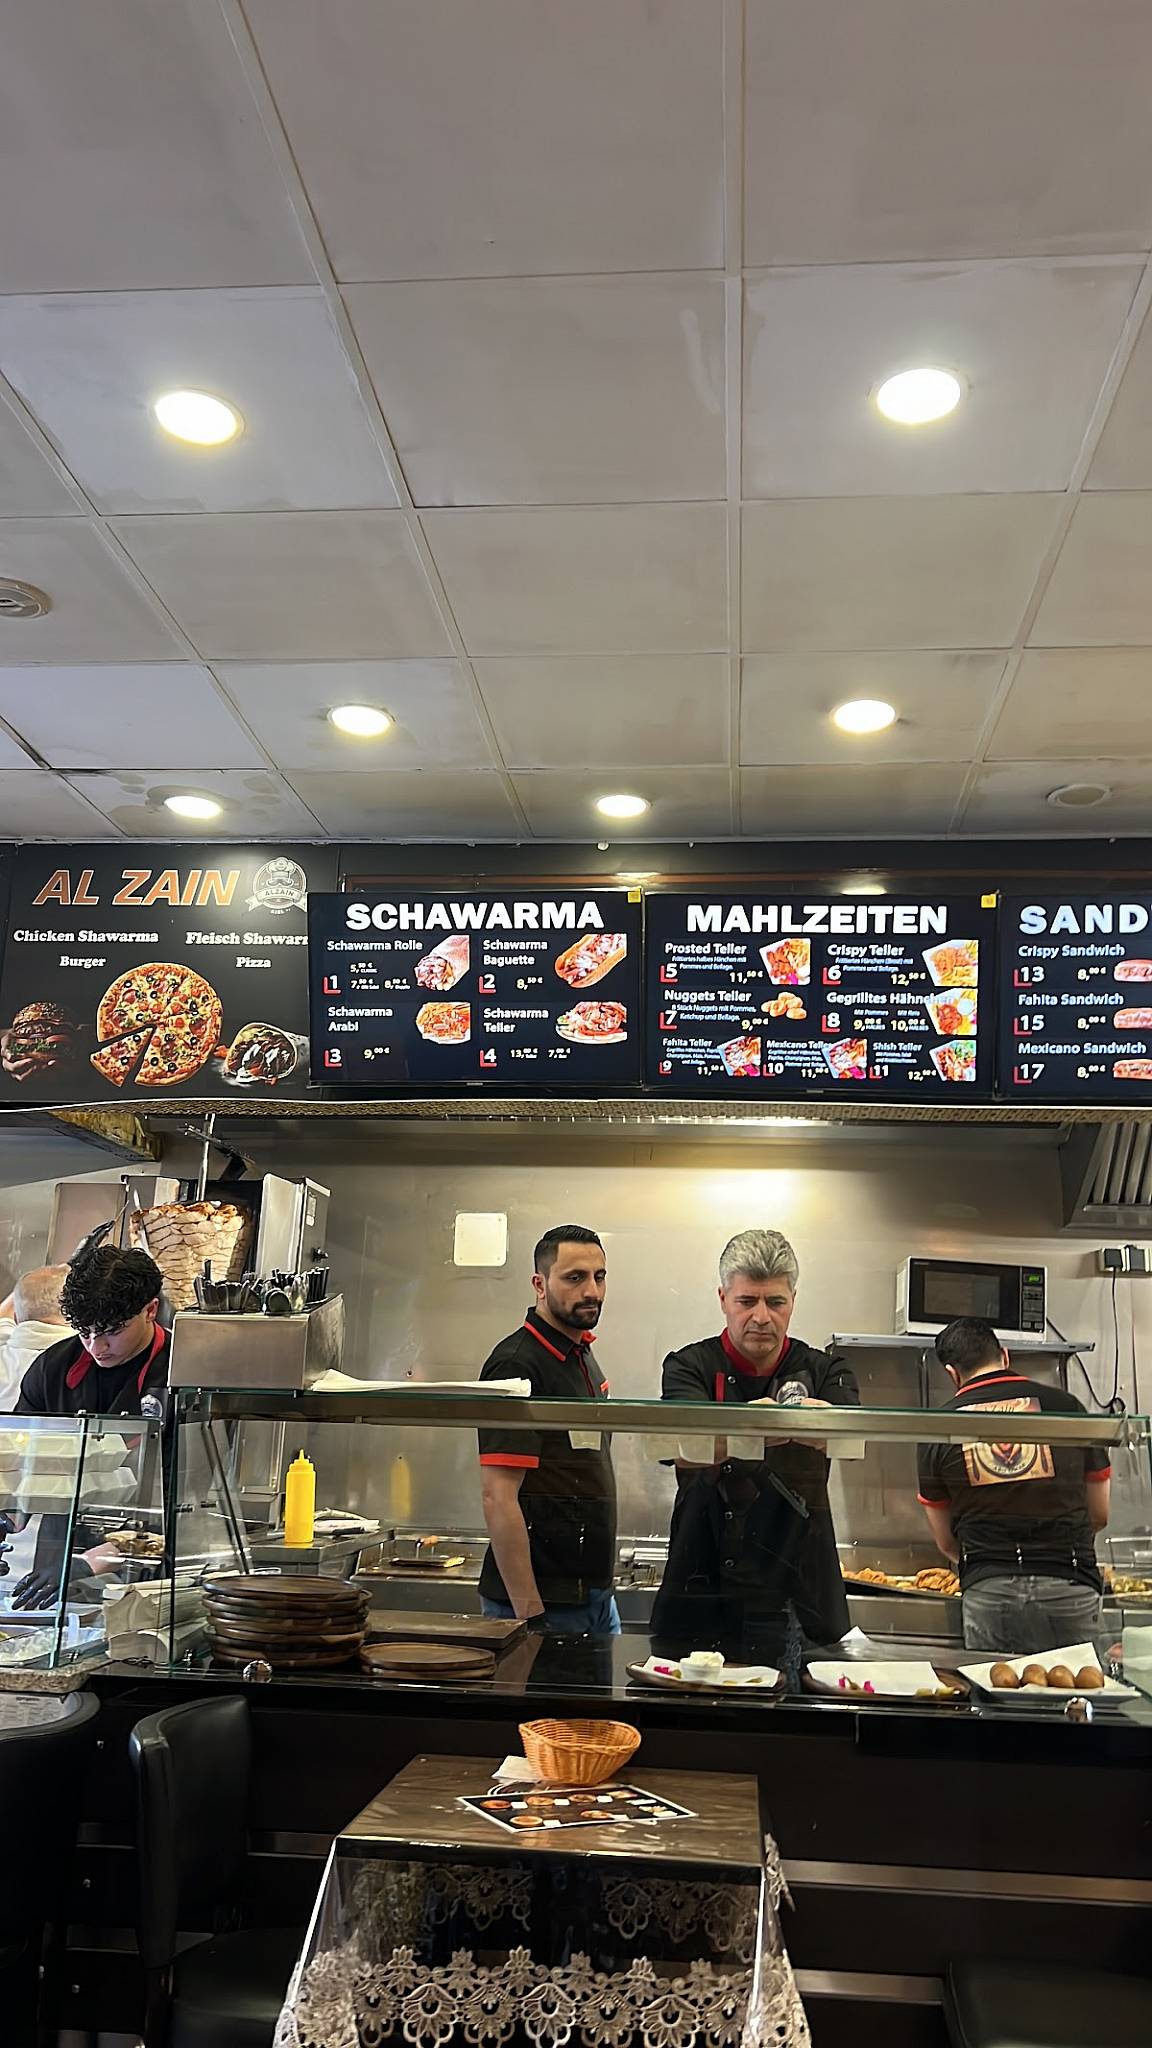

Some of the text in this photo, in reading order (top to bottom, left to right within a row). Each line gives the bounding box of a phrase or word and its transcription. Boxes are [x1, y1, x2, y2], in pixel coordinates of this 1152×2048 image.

[32, 869, 240, 906] AL ZAIN
[346, 902, 604, 930] SCHAWARMA
[688, 905, 947, 933] MAHLZEITEN
[1019, 904, 1149, 934] SAND
[14, 930, 158, 942] Chicken Shawarma
[186, 931, 240, 944] Fleisch
[327, 940, 422, 950] Schawarma Rolle
[483, 939, 547, 950] Schawarma
[665, 943, 747, 954] Prosted Teller
[828, 944, 904, 958] Crispy Teller
[1019, 944, 1125, 959] Crispy Sandwich
[60, 956, 106, 968] Burger
[236, 956, 271, 967] Pizza
[484, 955, 535, 967] Baguette
[666, 963, 677, 978] 5
[827, 965, 841, 981] 6
[1021, 966, 1044, 982] 13
[330, 975, 337, 989] 1
[484, 974, 495, 988] 2
[665, 990, 751, 1003] Nuggets Teller
[827, 992, 953, 1005] Gegrilltes Hähnch
[1019, 993, 1124, 1005] Fahita Sandwich
[328, 1006, 392, 1016] Schawarma
[484, 1008, 548, 1018] Schawarma
[665, 1010, 677, 1024] 7
[484, 1022, 515, 1032] Teller
[826, 1013, 840, 1028] 8
[1021, 1015, 1044, 1032] 15
[663, 1038, 712, 1047] Fahita Teller
[767, 1040, 807, 1050] Mexicano
[873, 1042, 922, 1051] Shish Teller
[1019, 1042, 1146, 1054] Mexicano Sandwich
[329, 1049, 341, 1064] 3
[483, 1049, 496, 1062] 4
[663, 1060, 672, 1071] 9
[767, 1063, 784, 1075] 10
[874, 1065, 888, 1077] 11
[1021, 1064, 1044, 1081] 17
